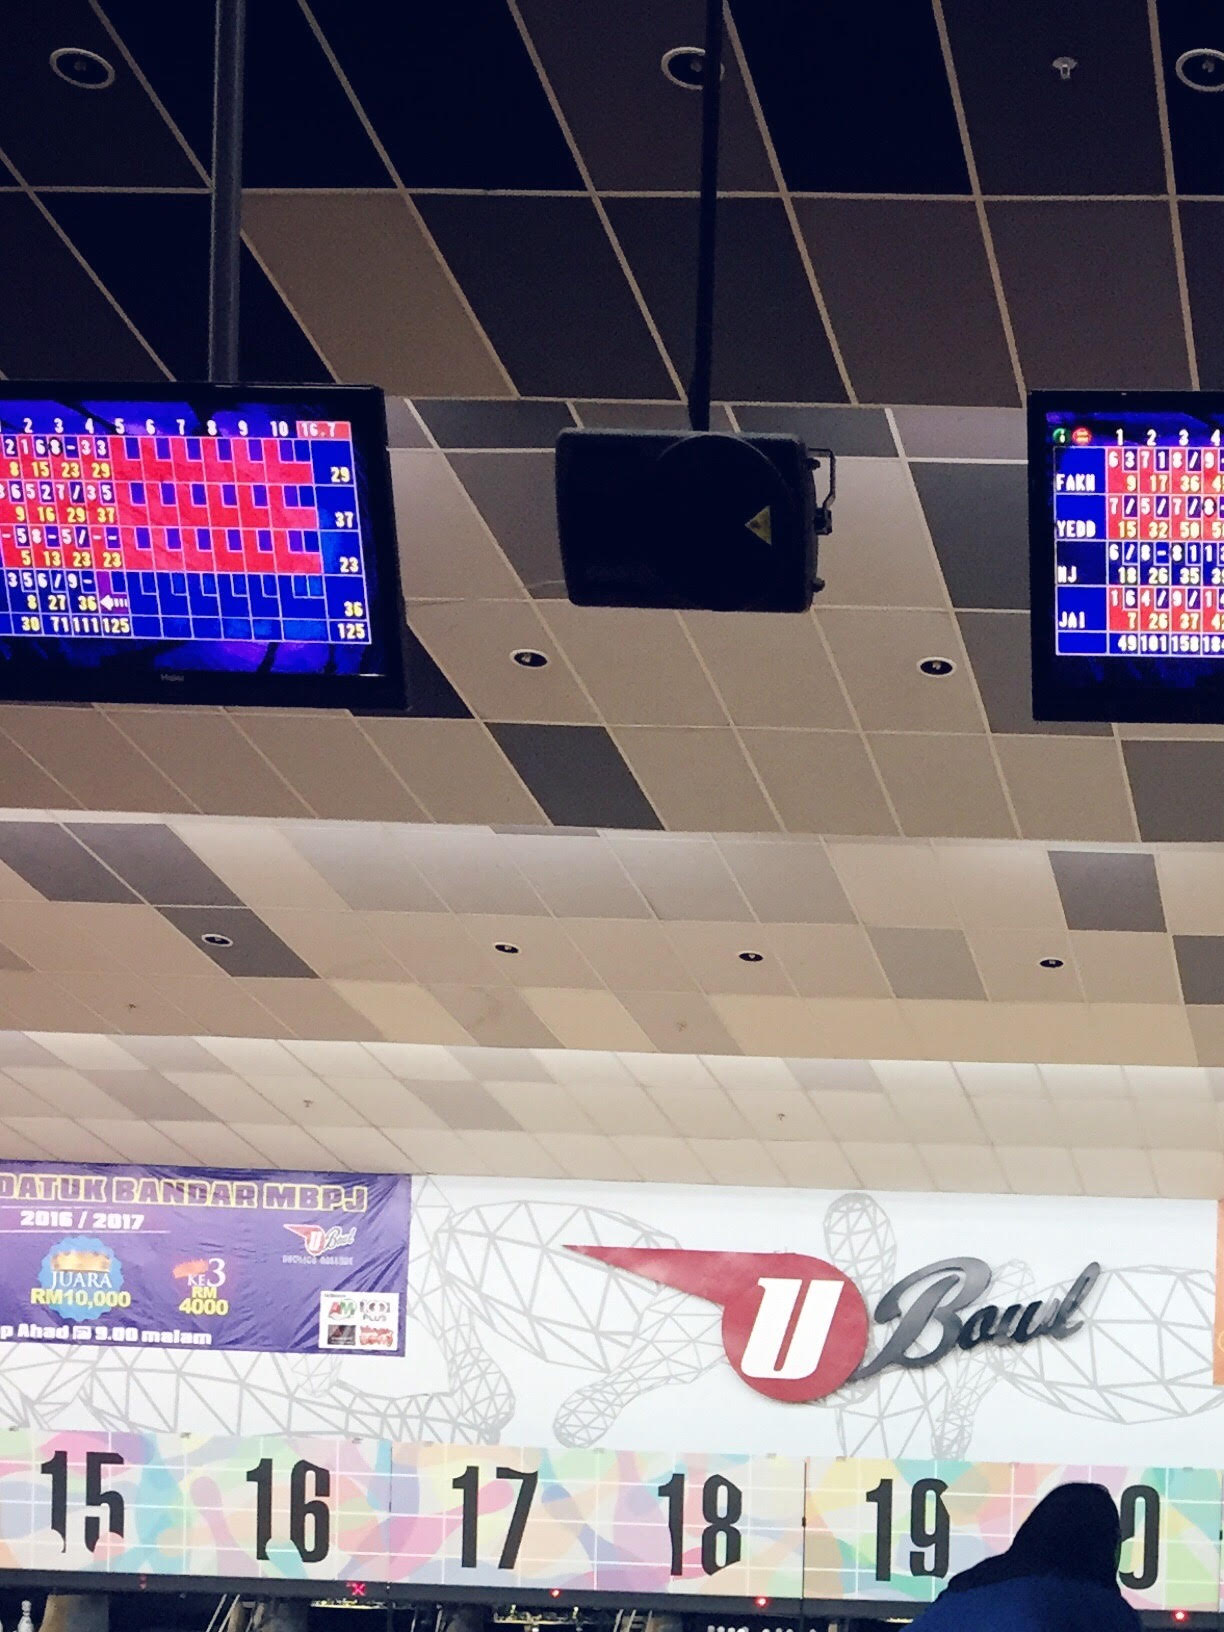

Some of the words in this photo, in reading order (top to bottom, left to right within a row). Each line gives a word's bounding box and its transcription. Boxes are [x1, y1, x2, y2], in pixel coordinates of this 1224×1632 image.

[24, 417, 33, 434] 2
[54, 418, 64, 434] 3
[85, 418, 94, 434] 4
[115, 418, 125, 434] 5
[145, 419, 156, 435] 6
[177, 419, 186, 435] 7
[207, 420, 218, 435] 8
[238, 421, 248, 436] 9
[269, 421, 289, 436] 10
[301, 422, 336, 436] 16.7
[1116, 428, 1124, 446] 1
[1147, 429, 1157, 446] 2
[1179, 429, 1189, 446] 3
[1211, 429, 1220, 447] 4
[61, 462, 79, 478] 23
[92, 462, 110, 478] 29
[330, 467, 350, 483] 29
[1150, 476, 1168, 491] 17
[1180, 476, 1200, 492] 36
[67, 507, 86, 522] 29
[98, 507, 115, 522] 37
[335, 511, 353, 528] 37
[1118, 522, 1137, 538] 15
[1149, 522, 1168, 538] 32
[1180, 522, 1200, 539] 50
[103, 552, 121, 567] 23
[340, 556, 359, 572] 23
[1118, 567, 1137, 584] 18
[1149, 567, 1168, 584] 26
[1180, 567, 1200, 584] 35
[48, 595, 66, 610] 27
[78, 595, 97, 611] 36
[344, 601, 363, 617] 36
[51, 617, 70, 632] 71
[73, 618, 99, 633] 111
[103, 618, 130, 634] 125
[338, 623, 365, 639] 125
[1149, 612, 1168, 629] 26
[1180, 612, 1200, 629] 37
[1118, 635, 1137, 651] 49
[1141, 635, 1167, 651] 101
[1172, 636, 1199, 652] 158
[0, 1172, 107, 1202] DATUK
[112, 1176, 258, 1208] BANDAR
[262, 1182, 368, 1212] MBPJ
[20, 1210, 73, 1228] 2016
[78, 1211, 88, 1229] /
[92, 1213, 145, 1230] 2017
[51, 1271, 112, 1290] JUARA
[187, 1274, 206, 1287] KE
[207, 1258, 226, 1287] 3
[30, 1288, 131, 1309] RM10,000
[191, 1286, 217, 1299] RM
[179, 1299, 229, 1316] 4000
[850, 1256, 1100, 1381] Bowl
[17, 1323, 69, 1340] Ahad
[94, 1326, 139, 1342] 9.00
[141, 1329, 212, 1345] malam
[41, 1450, 125, 1553] 15
[246, 1458, 330, 1564] 16
[451, 1465, 539, 1570] 17
[658, 1473, 743, 1576] 18
[866, 1477, 950, 1582] 19
[1119, 1485, 1160, 1590] 0
